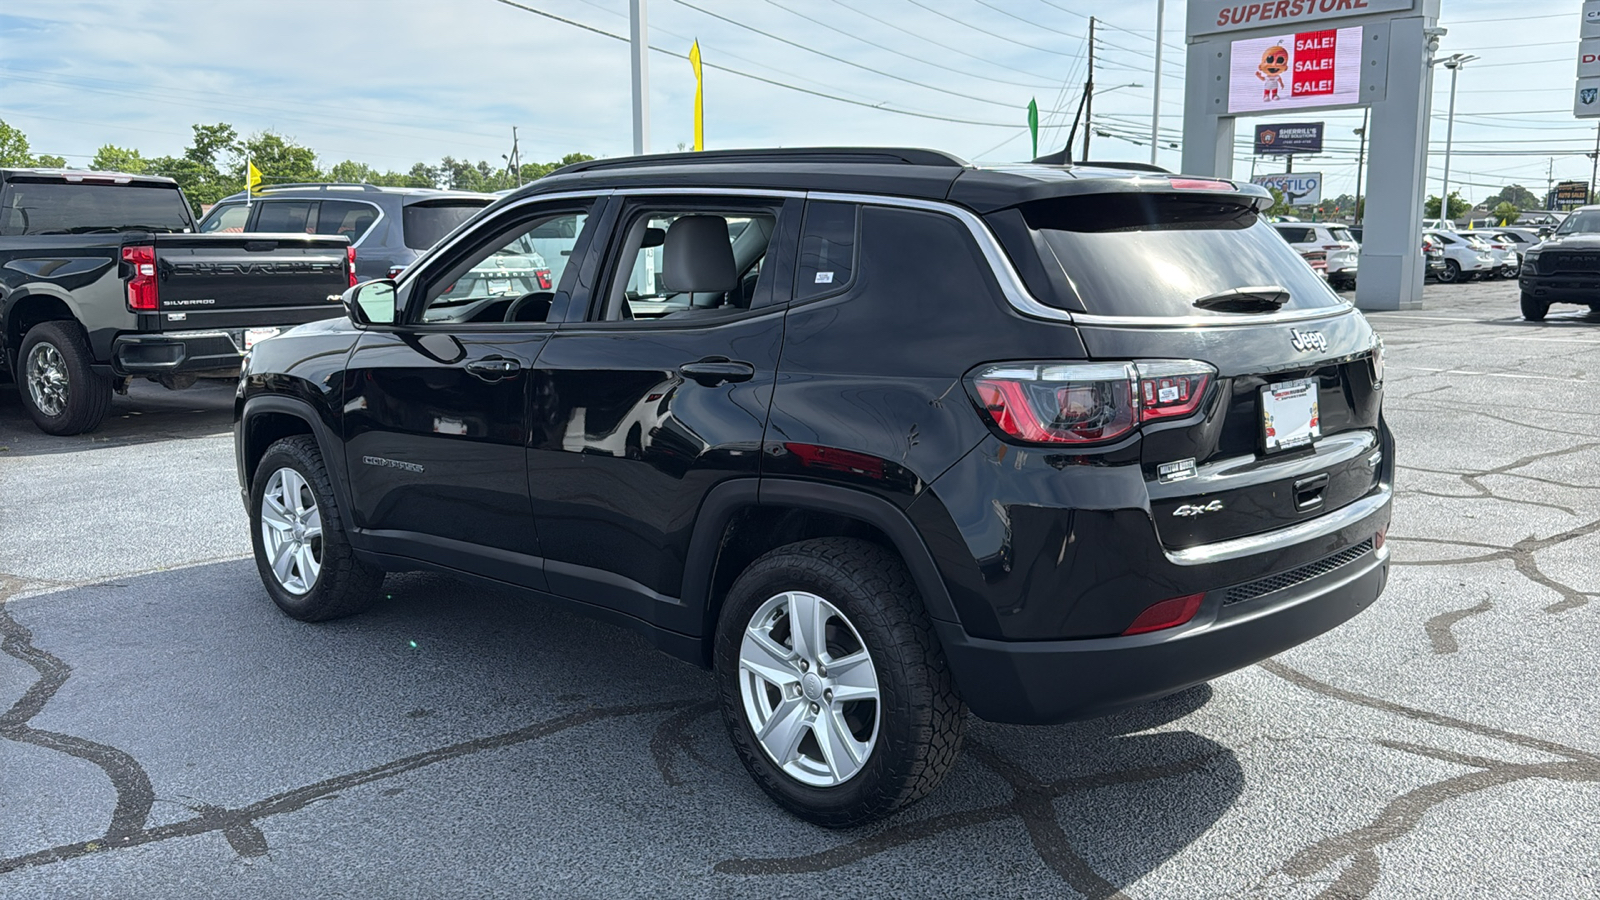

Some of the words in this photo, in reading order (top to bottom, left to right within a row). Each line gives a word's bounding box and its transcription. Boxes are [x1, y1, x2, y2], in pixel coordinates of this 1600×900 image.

[1216, 0, 1369, 27] SUPERSTORE
[1296, 37, 1334, 51] SALE!
[1294, 60, 1333, 72] SALE!
[1293, 80, 1332, 93] SALE!
[174, 263, 343, 276] CHEVROLET
[163, 298, 216, 306] SILVERADO
[1291, 328, 1327, 352] Jeep
[362, 455, 425, 473] COMPASS
[1172, 499, 1224, 517] 4x4
